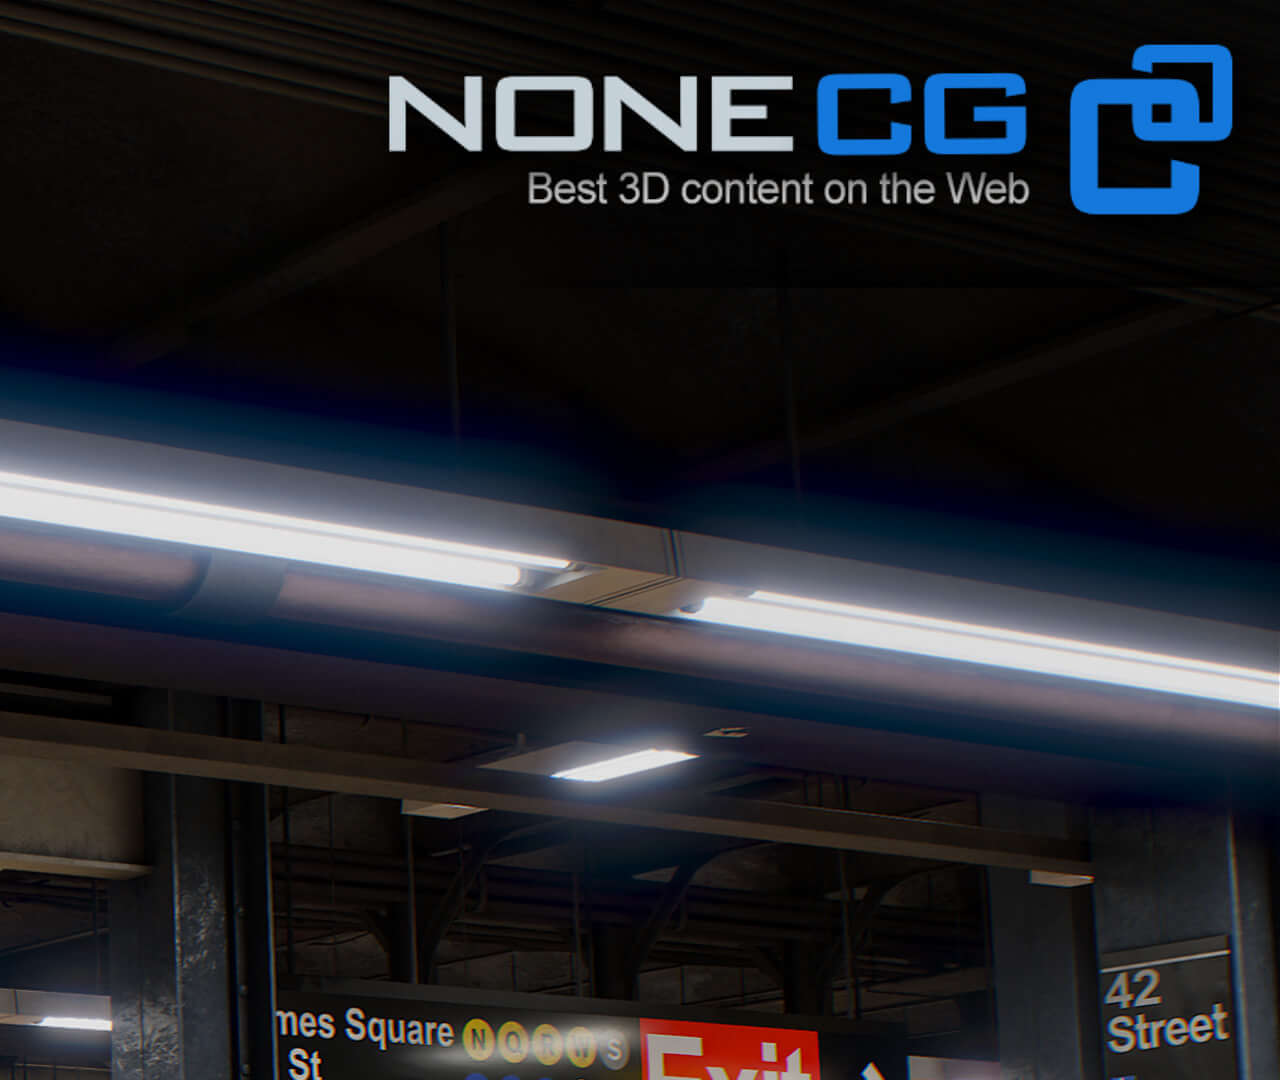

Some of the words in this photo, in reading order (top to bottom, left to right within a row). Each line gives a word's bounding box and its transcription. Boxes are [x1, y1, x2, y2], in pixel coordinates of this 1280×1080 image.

[1103, 967, 1163, 1010] 42
[345, 1007, 456, 1050] Square
[1106, 1002, 1231, 1054] Street
